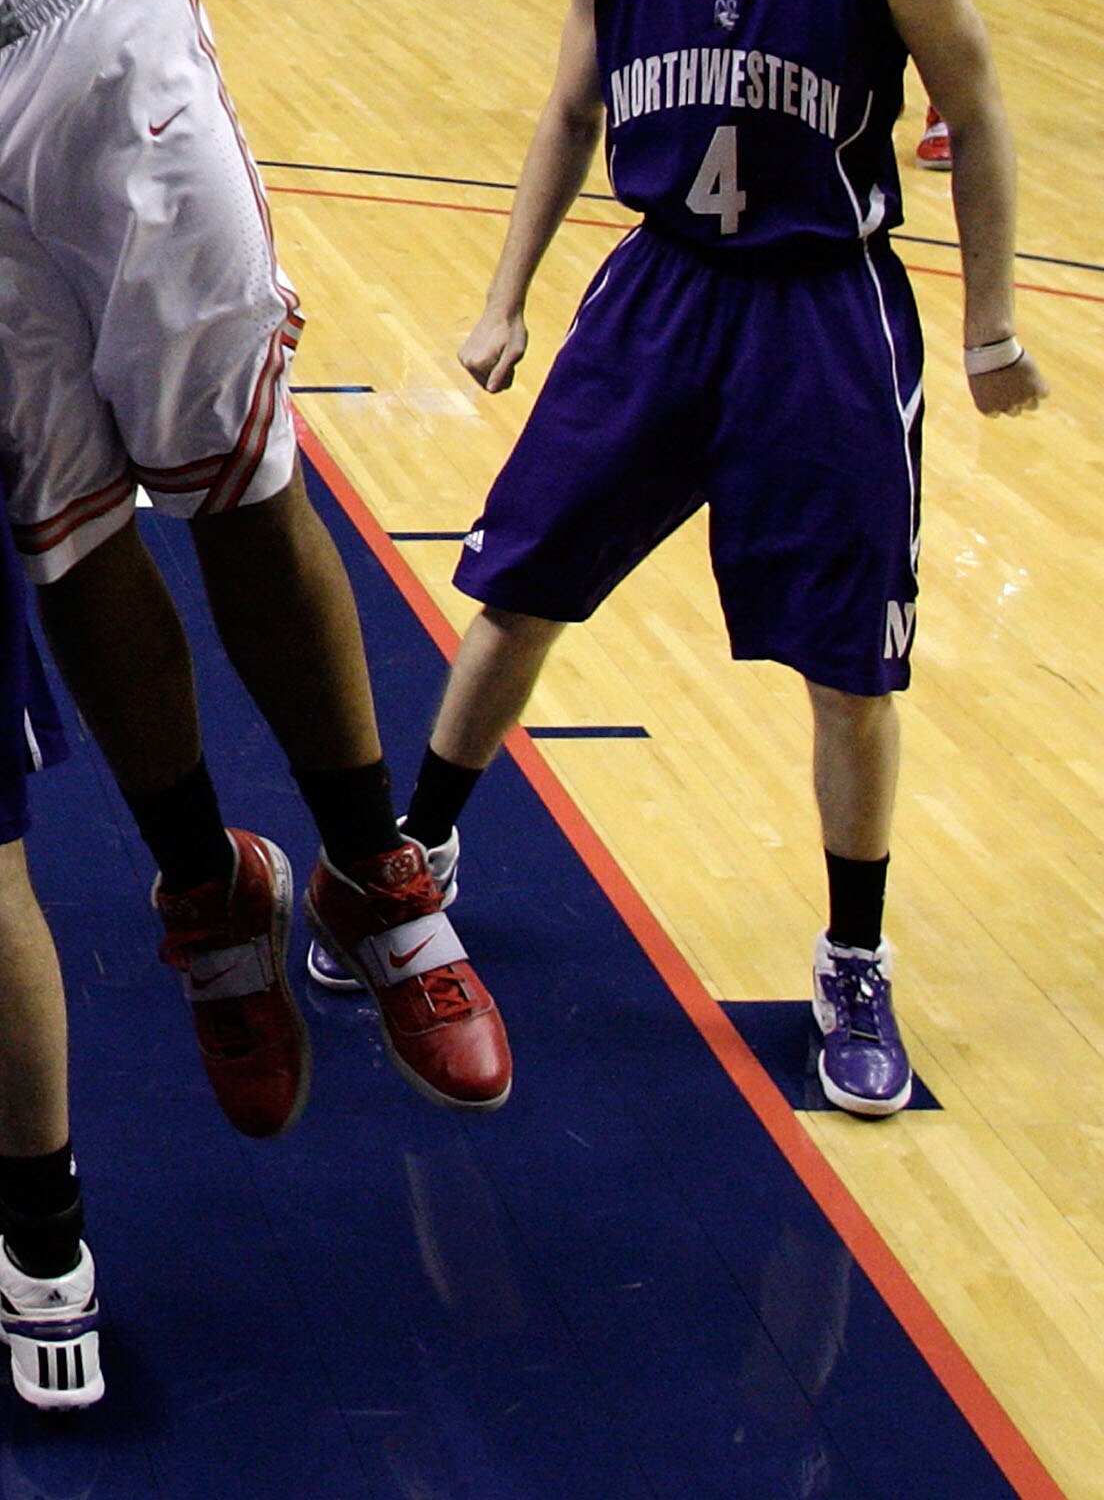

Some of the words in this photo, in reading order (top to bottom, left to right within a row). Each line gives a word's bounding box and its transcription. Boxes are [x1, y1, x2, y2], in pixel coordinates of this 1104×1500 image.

[610, 48, 841, 140] NORTHWESTERN
[685, 125, 746, 236] 4
[884, 601, 916, 659] N
